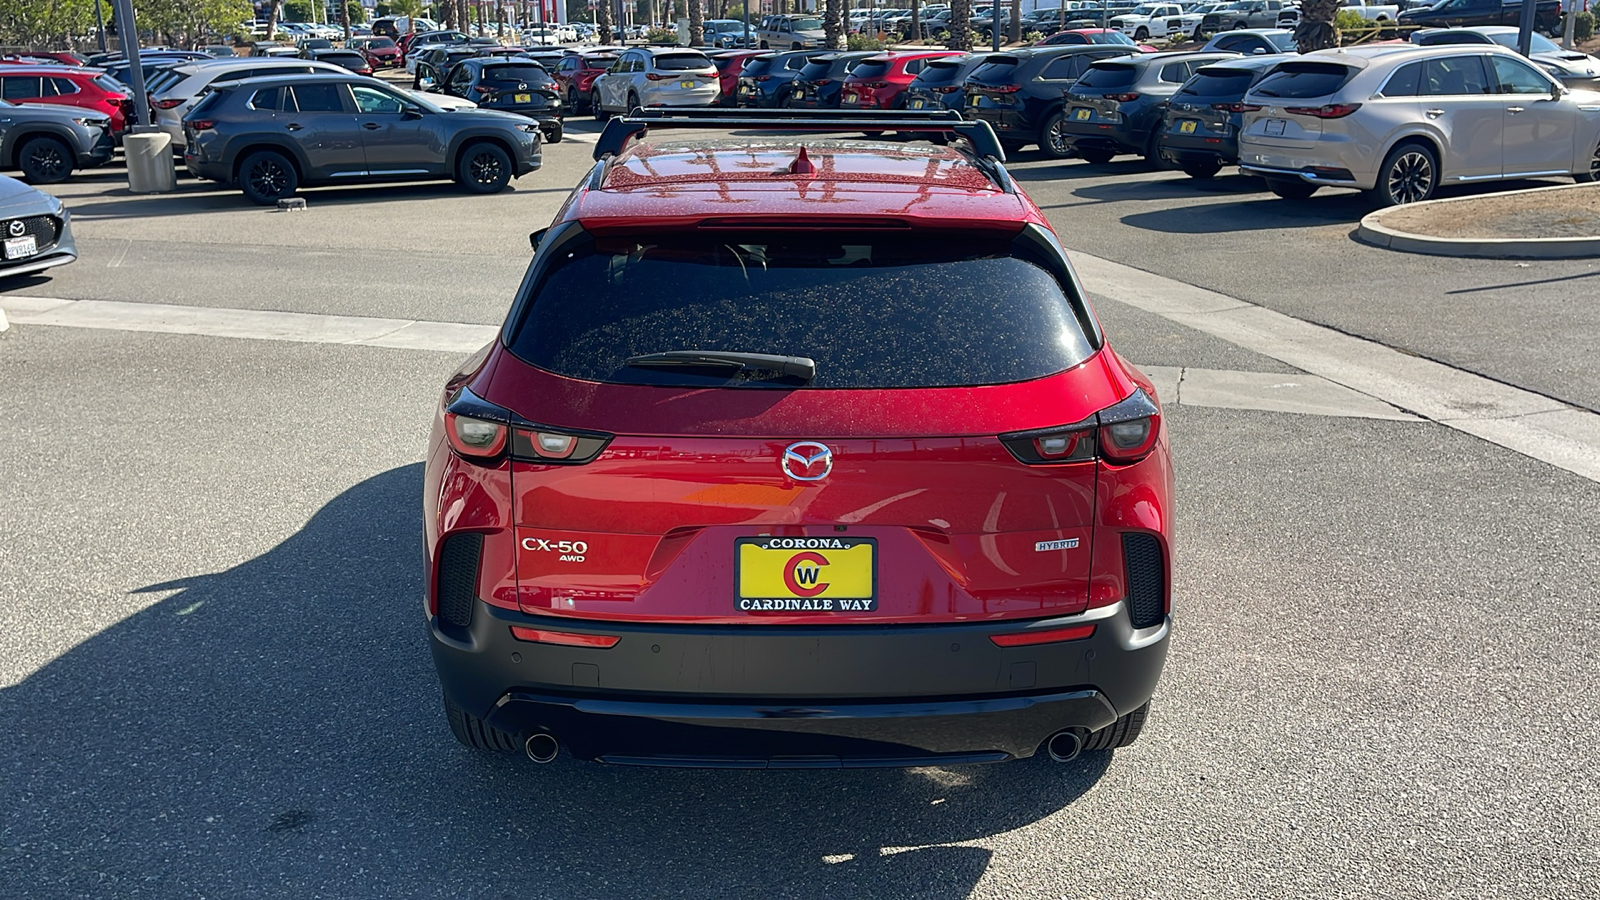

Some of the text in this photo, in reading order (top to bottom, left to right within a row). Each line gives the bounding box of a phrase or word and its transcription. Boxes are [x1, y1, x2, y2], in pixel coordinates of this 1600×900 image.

[521, 537, 588, 554] CX-50
[769, 538, 843, 549] CORONA
[1039, 540, 1077, 550] HYBRID
[559, 555, 586, 563] AWD
[784, 551, 830, 597] C W
[740, 599, 872, 610] CARDINALE WAY
